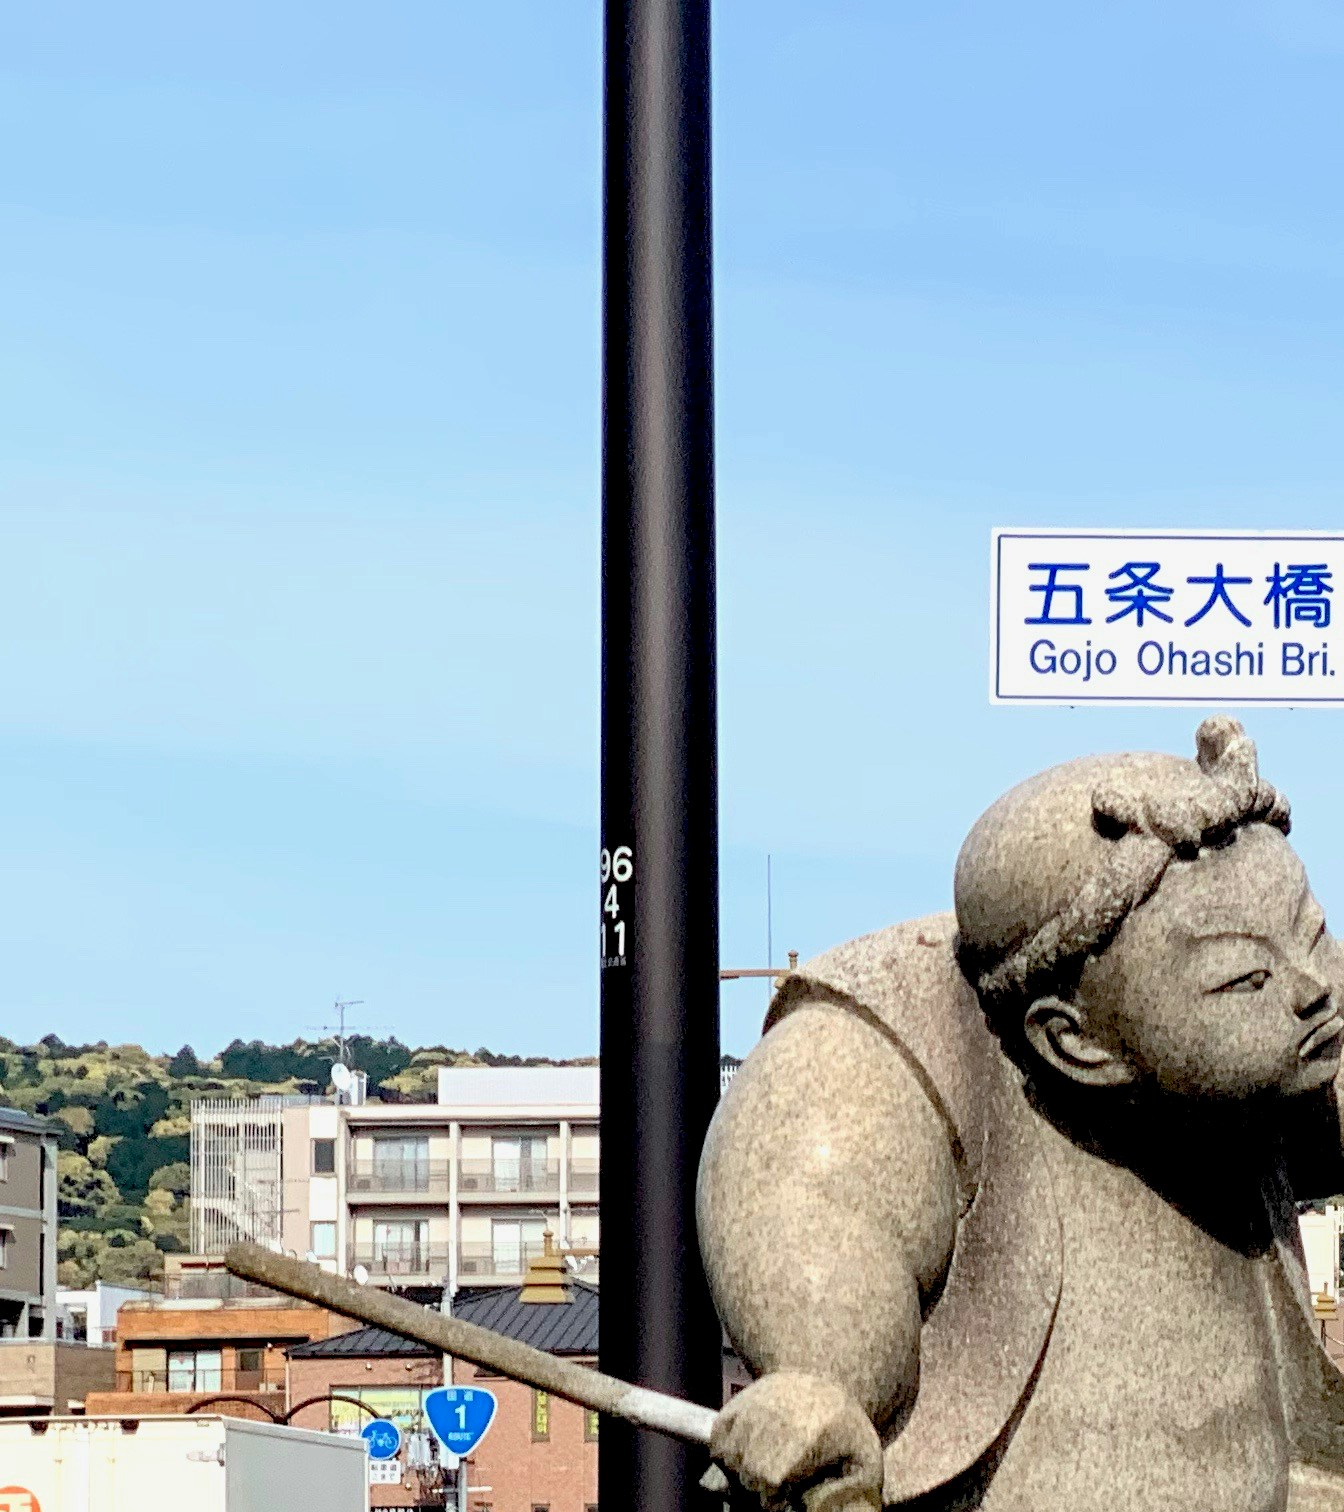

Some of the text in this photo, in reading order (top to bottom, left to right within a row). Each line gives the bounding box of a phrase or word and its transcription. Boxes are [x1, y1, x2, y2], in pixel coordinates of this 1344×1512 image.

[1023, 560, 1335, 630] 五条大橋
[1028, 638, 1336, 683] Gojo Ohashi Bri.
[454, 1403, 467, 1430] 1
